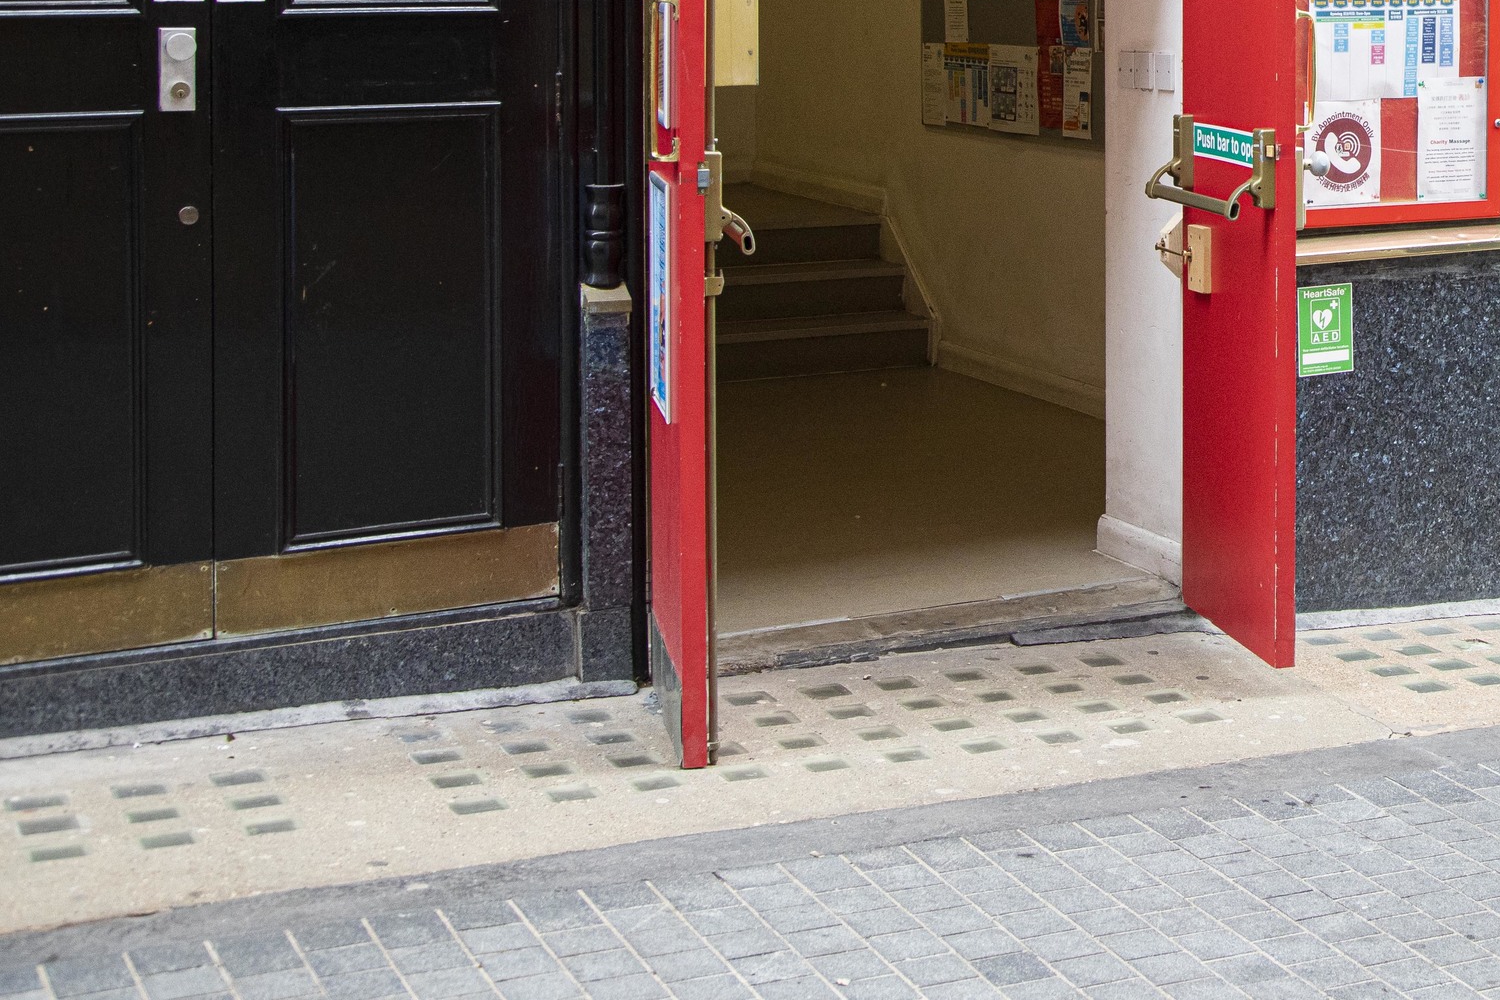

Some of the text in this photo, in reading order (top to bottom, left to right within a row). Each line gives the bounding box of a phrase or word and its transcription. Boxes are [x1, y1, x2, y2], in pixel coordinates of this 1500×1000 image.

[1311, 111, 1375, 142] By Appointment Only
[1196, 129, 1216, 150] Push
[1217, 132, 1230, 152] bar
[1231, 136, 1239, 155] to
[1303, 287, 1345, 299] HeartSafe
